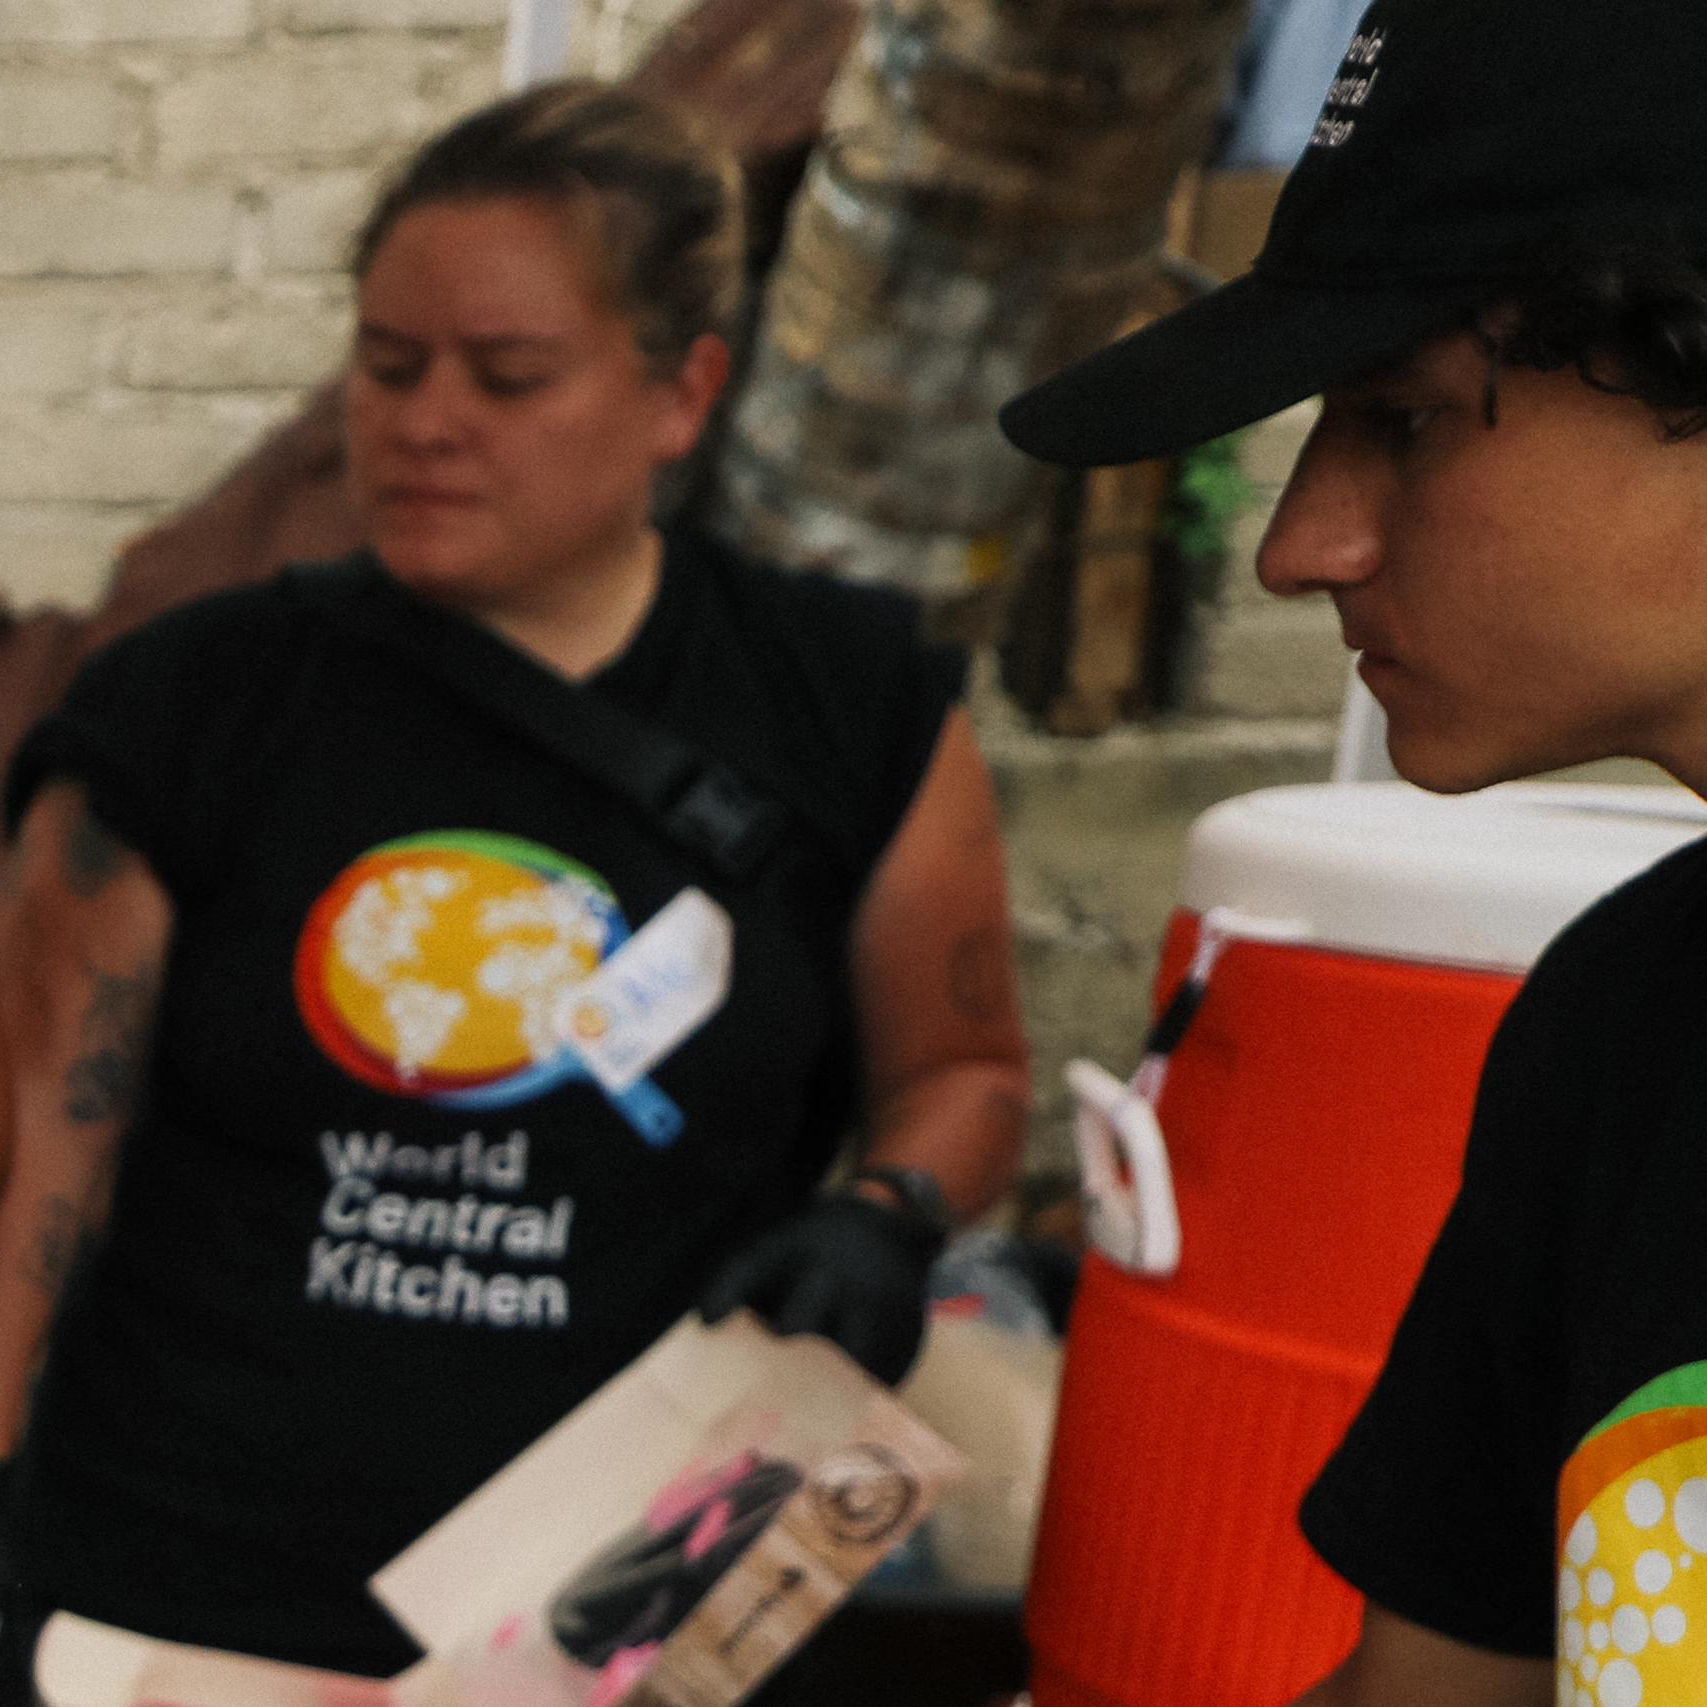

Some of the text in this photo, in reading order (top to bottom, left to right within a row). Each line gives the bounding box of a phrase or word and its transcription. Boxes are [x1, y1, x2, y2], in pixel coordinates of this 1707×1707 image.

[321, 1130, 527, 1187] World
[322, 1177, 573, 1258] Central
[308, 1237, 568, 1326] Kitchen
